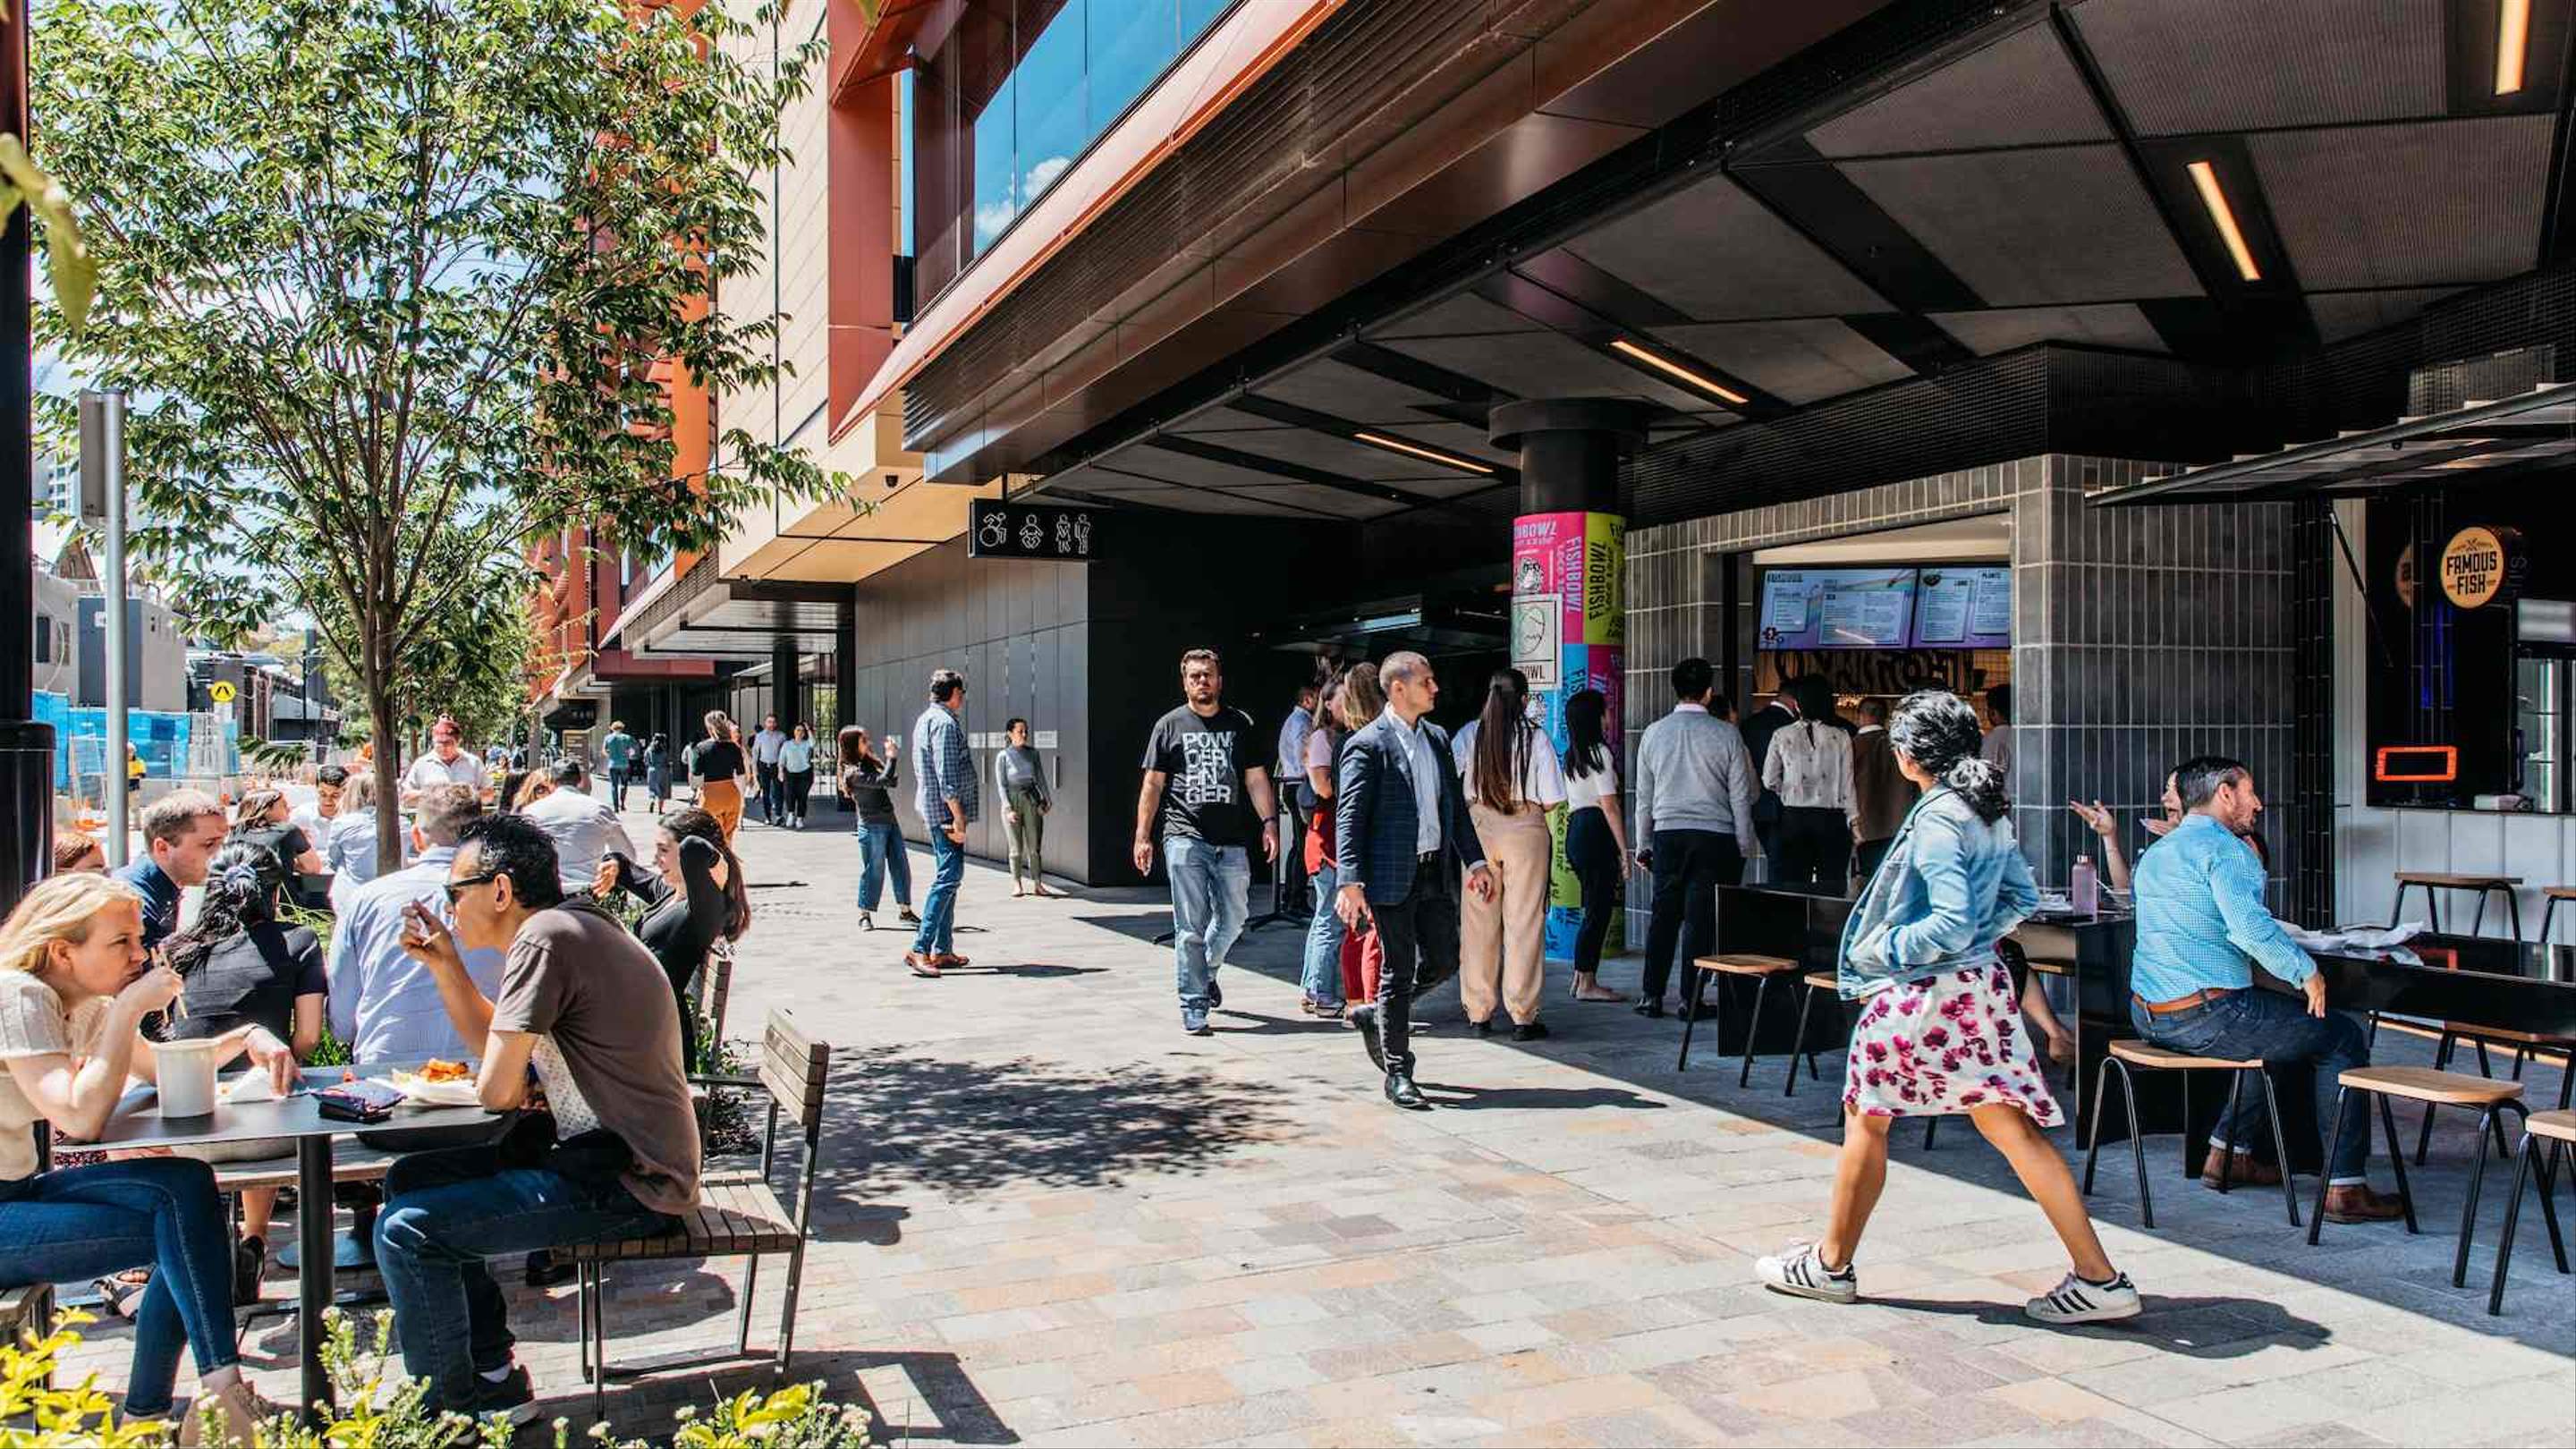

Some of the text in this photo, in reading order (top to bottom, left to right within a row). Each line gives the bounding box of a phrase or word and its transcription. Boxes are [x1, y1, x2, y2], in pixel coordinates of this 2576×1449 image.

[2446, 550, 2497, 575] FAMOUS
[1566, 537, 1581, 613] FISHBOWL
[1589, 540, 1607, 621] FISHBOWL
[2457, 574, 2486, 595] FISH
[1522, 665, 1546, 680] OWL
[1186, 784, 1231, 804] GER
